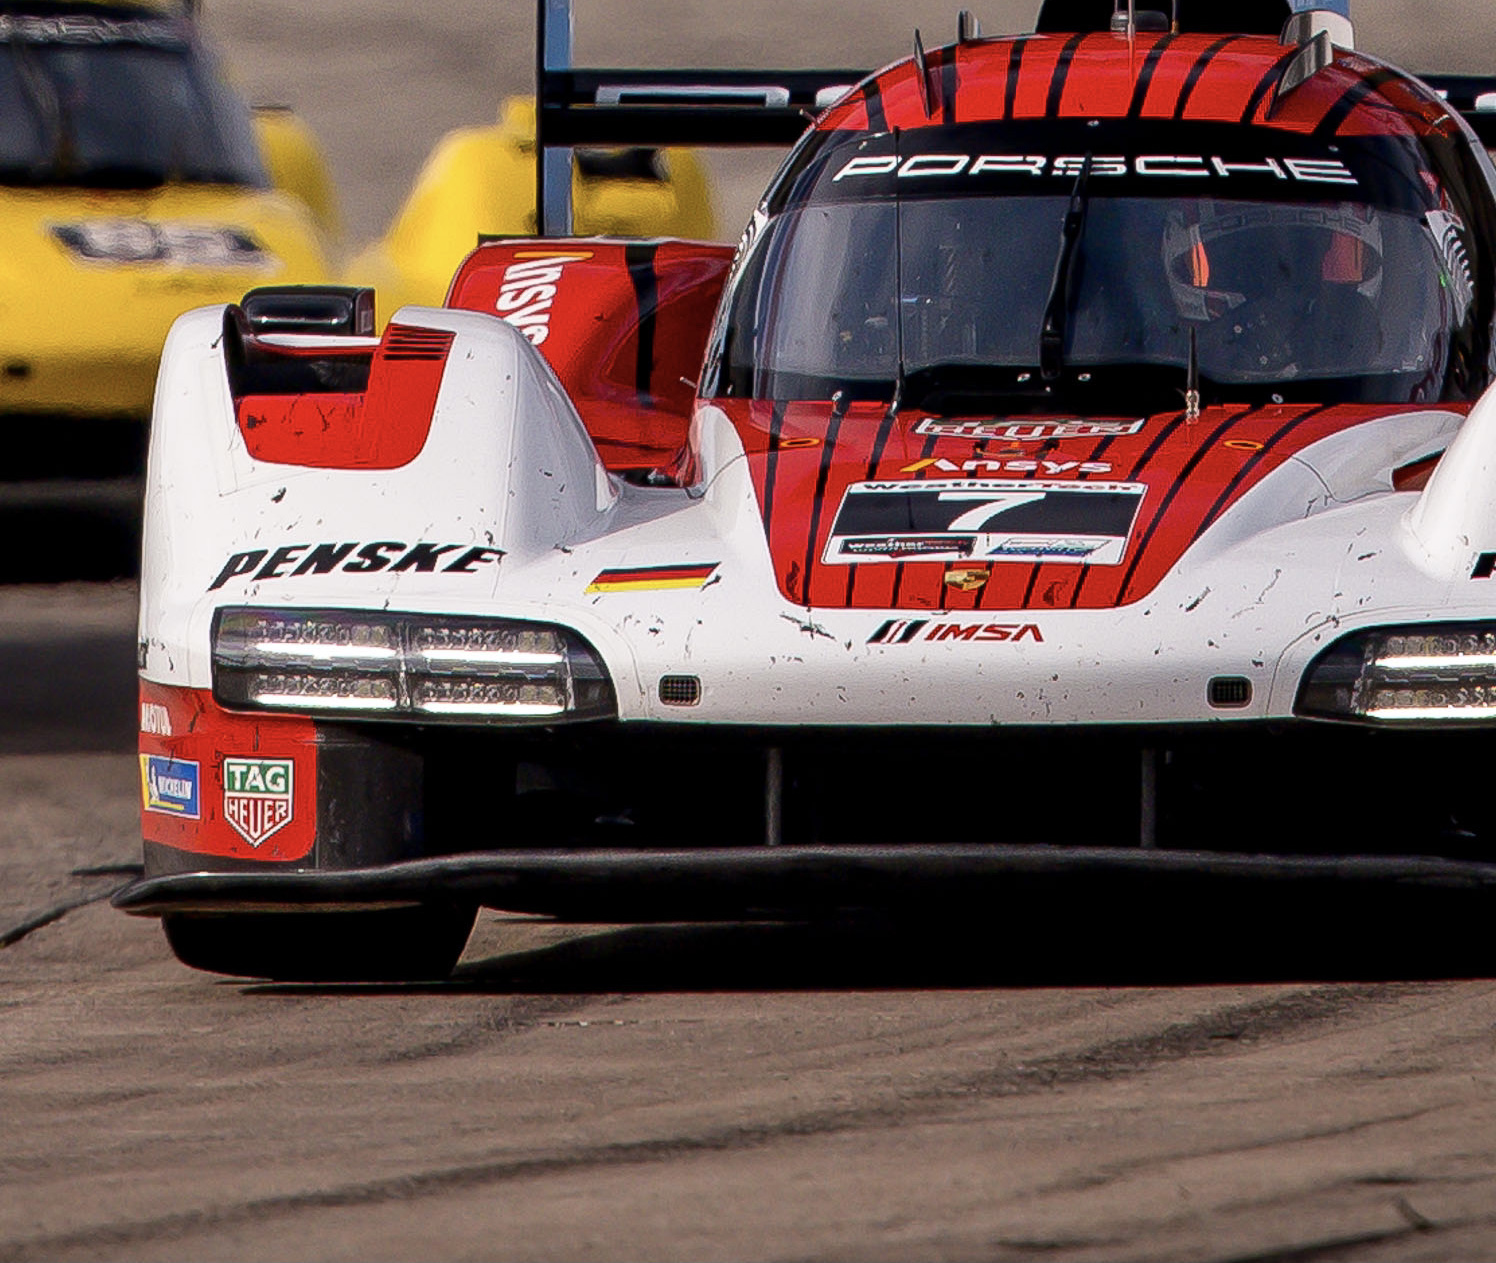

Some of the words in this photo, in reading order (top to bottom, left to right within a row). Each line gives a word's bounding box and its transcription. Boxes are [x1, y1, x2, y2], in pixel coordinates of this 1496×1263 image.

[833, 155, 1359, 185] PORSCHE
[900, 458, 1113, 474] Ansys
[937, 492, 1047, 531] 7
[207, 541, 507, 591] PENSKE
[924, 623, 1045, 643] IMSA
[229, 764, 286, 793] TAG
[228, 800, 287, 835] HEUER
